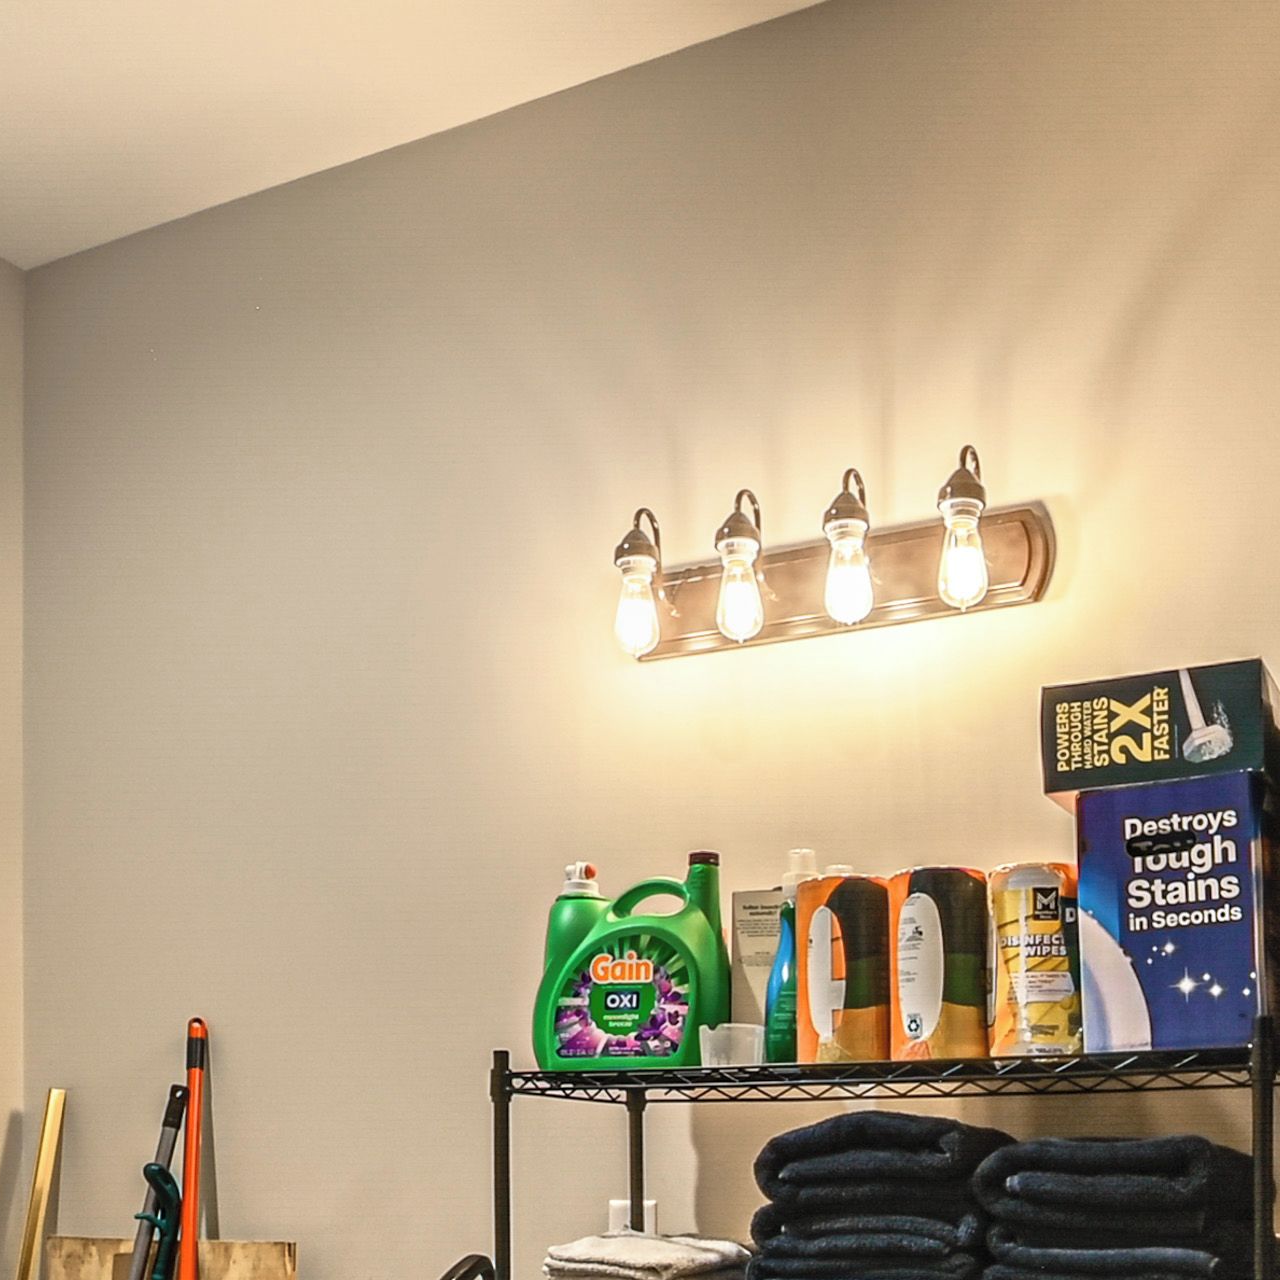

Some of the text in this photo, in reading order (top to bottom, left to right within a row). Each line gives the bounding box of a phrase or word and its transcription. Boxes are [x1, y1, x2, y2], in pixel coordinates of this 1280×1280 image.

[1056, 702, 1070, 772] POWERS
[1070, 701, 1082, 771] THROUGH
[1082, 700, 1093, 769] HARD WATER
[1093, 696, 1110, 767] STAINS
[1110, 693, 1152, 765] 2X
[1152, 687, 1170, 761] FASTER
[1124, 810, 1237, 841] Destroys
[1127, 872, 1240, 909] Stains
[1128, 903, 1242, 931] in Seconds
[590, 950, 655, 984] Gain
[606, 994, 637, 1008] OXI
